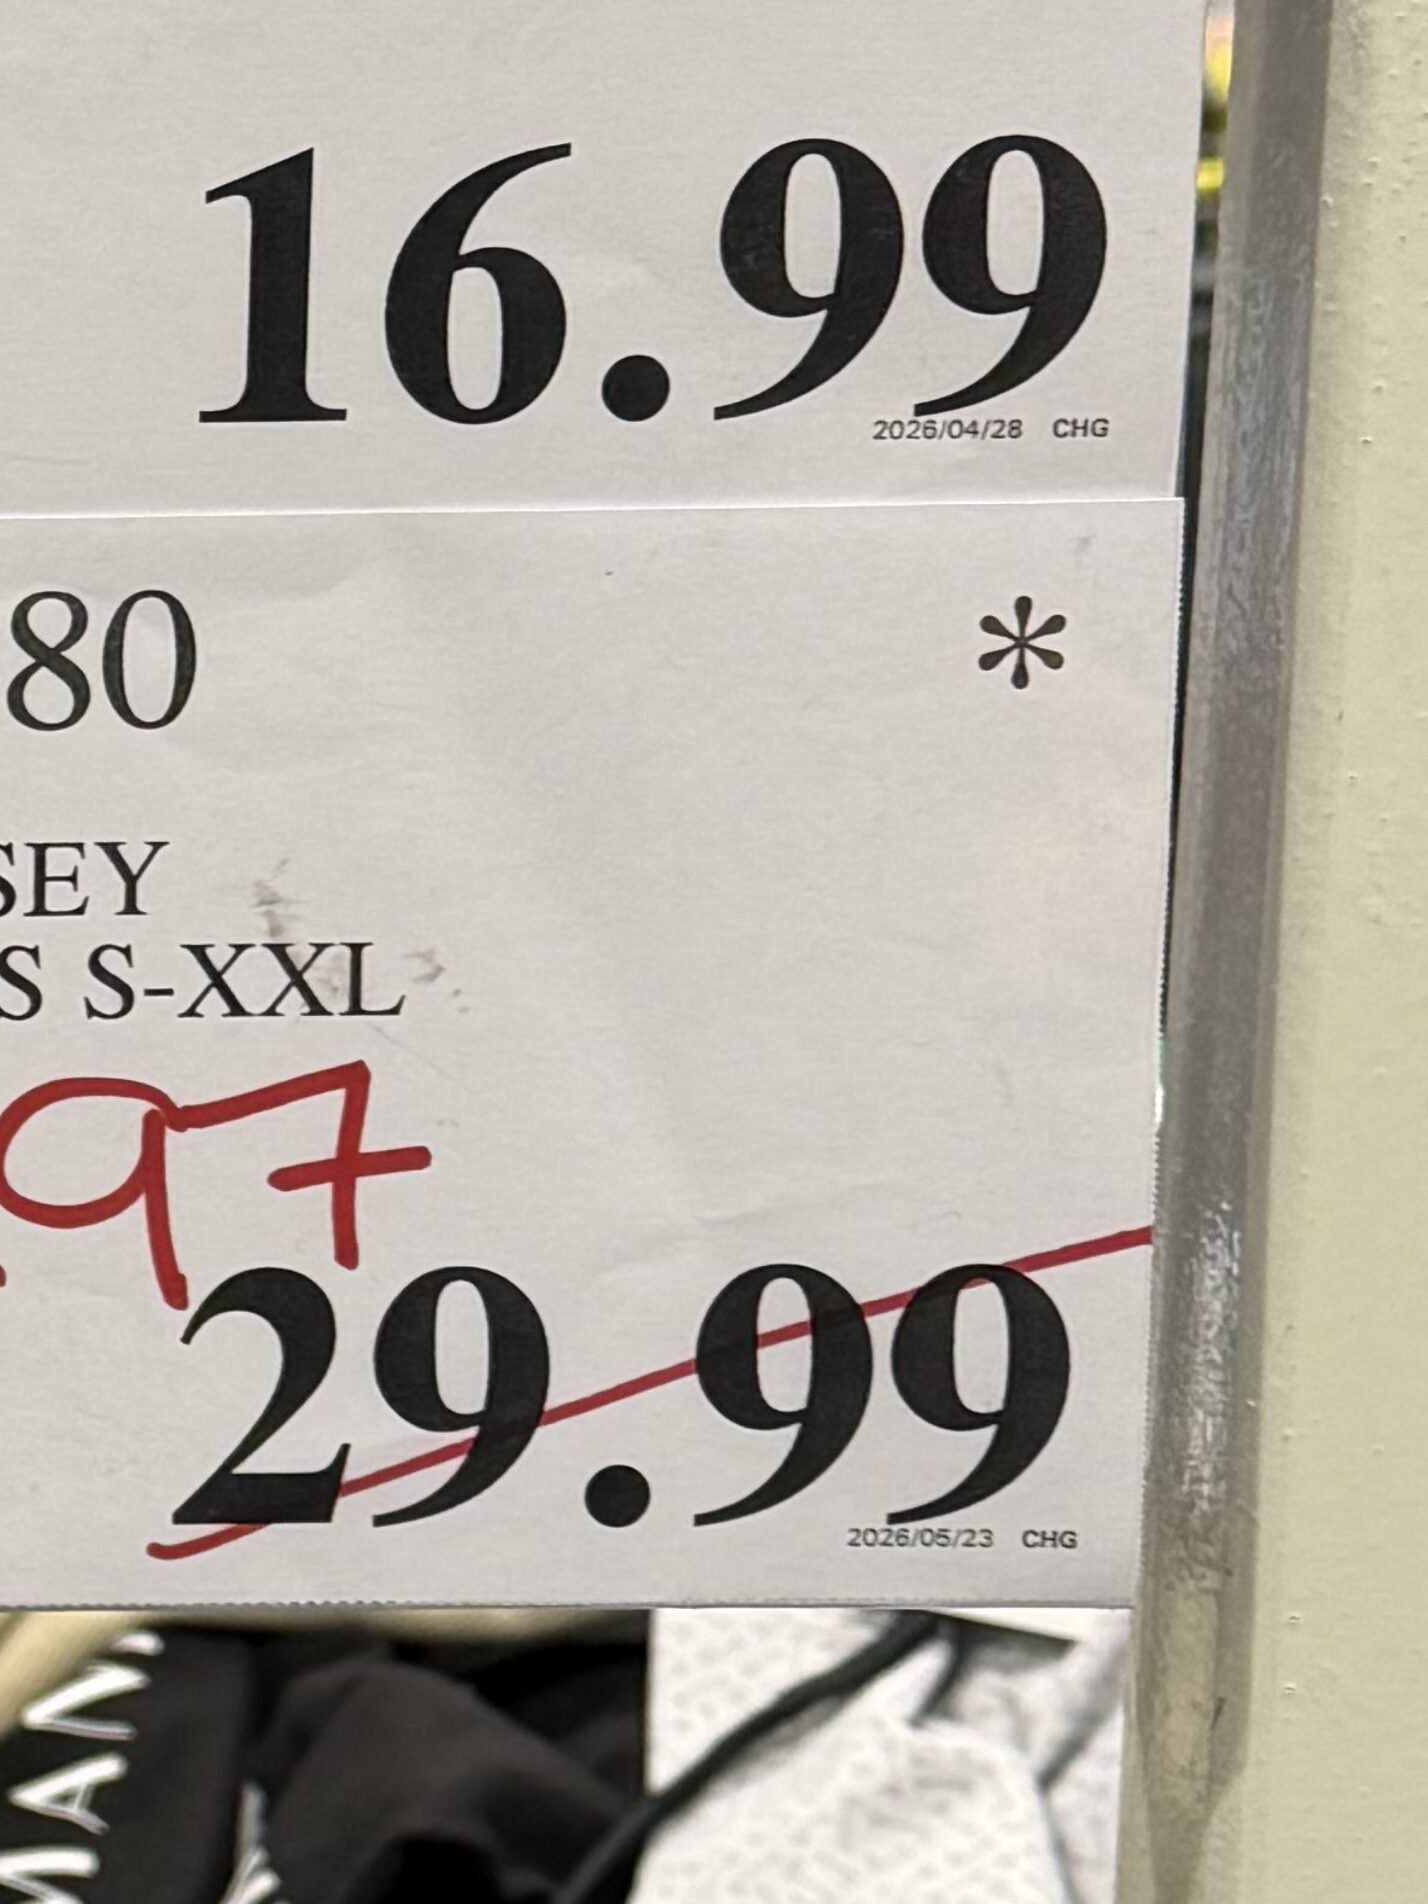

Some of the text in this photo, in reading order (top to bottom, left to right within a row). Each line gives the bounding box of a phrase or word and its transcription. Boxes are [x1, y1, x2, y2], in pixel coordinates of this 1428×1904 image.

[197, 133, 1109, 430] 16.99
[872, 417, 1110, 441] 2026/04/28 CHG
[83, 941, 406, 1021] S-XXL
[170, 1259, 1073, 1530] 29.99
[847, 1527, 1078, 1550] 2026/05/23 CHG
